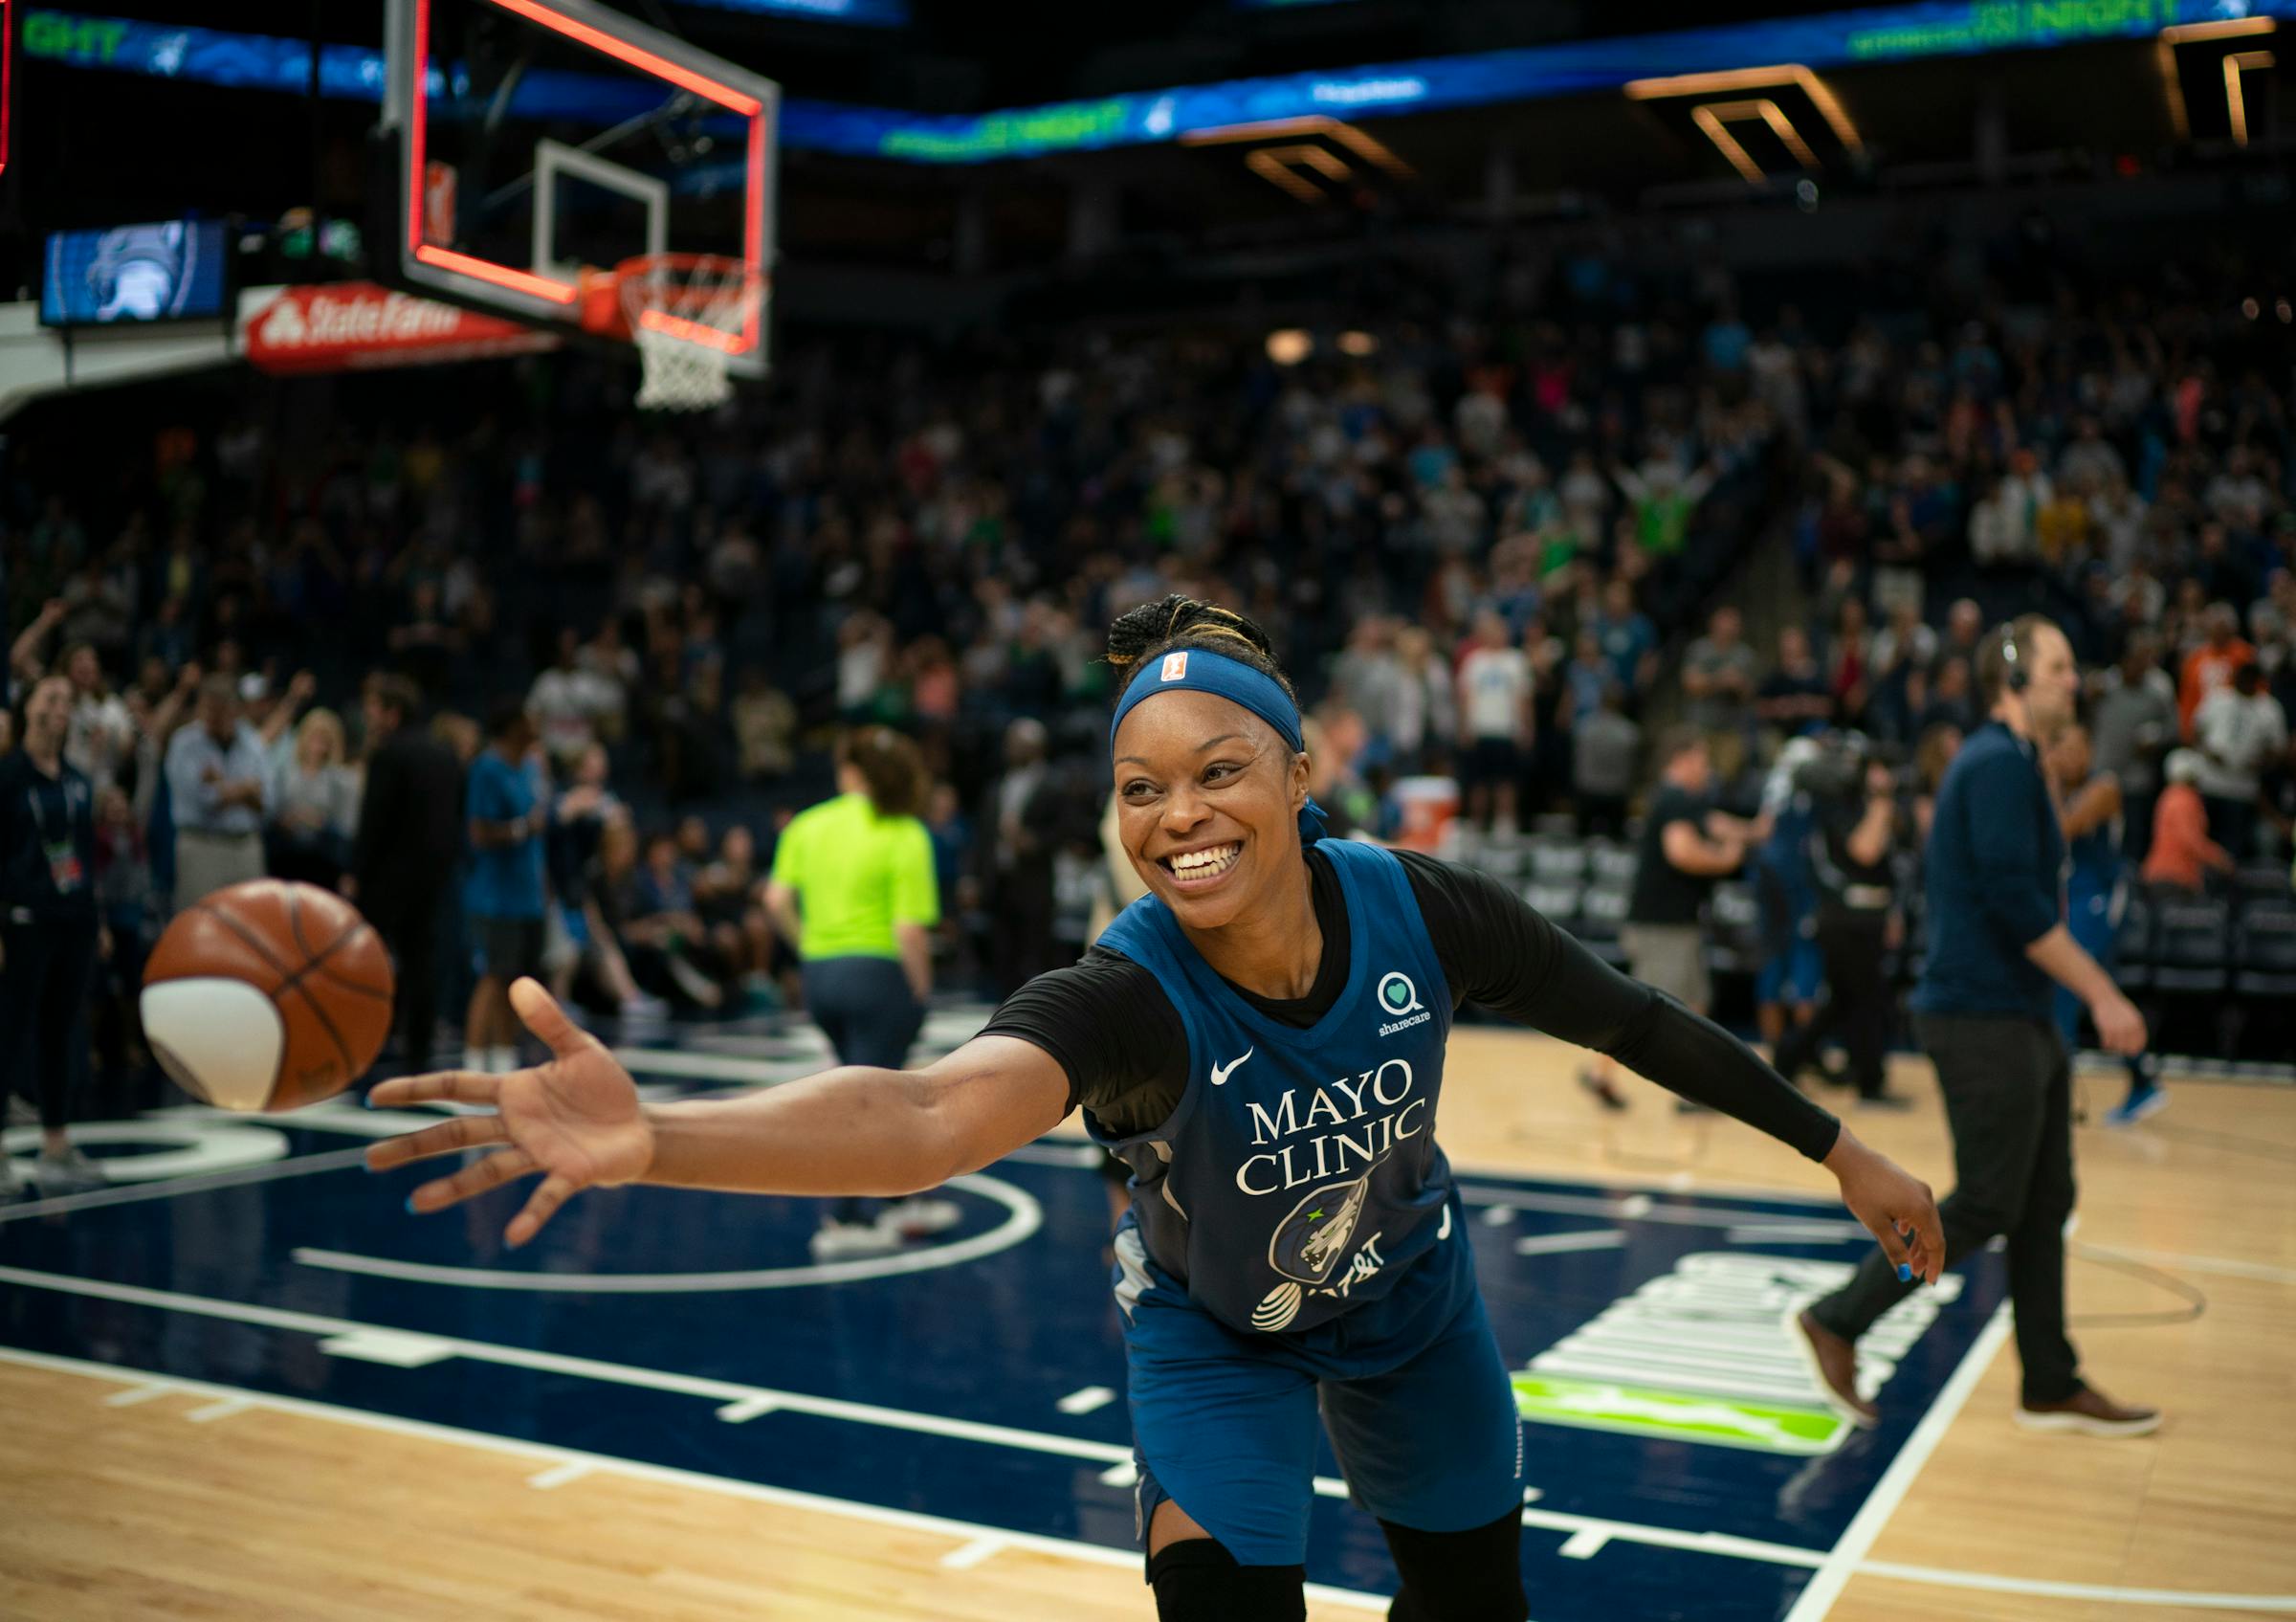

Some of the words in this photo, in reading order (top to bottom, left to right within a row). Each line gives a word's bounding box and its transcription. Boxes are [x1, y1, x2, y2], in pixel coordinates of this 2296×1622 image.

[1379, 1011, 1431, 1037] sharecare
[1246, 1058, 1413, 1145] MAYO
[1236, 1098, 1425, 1196] CLINIC
